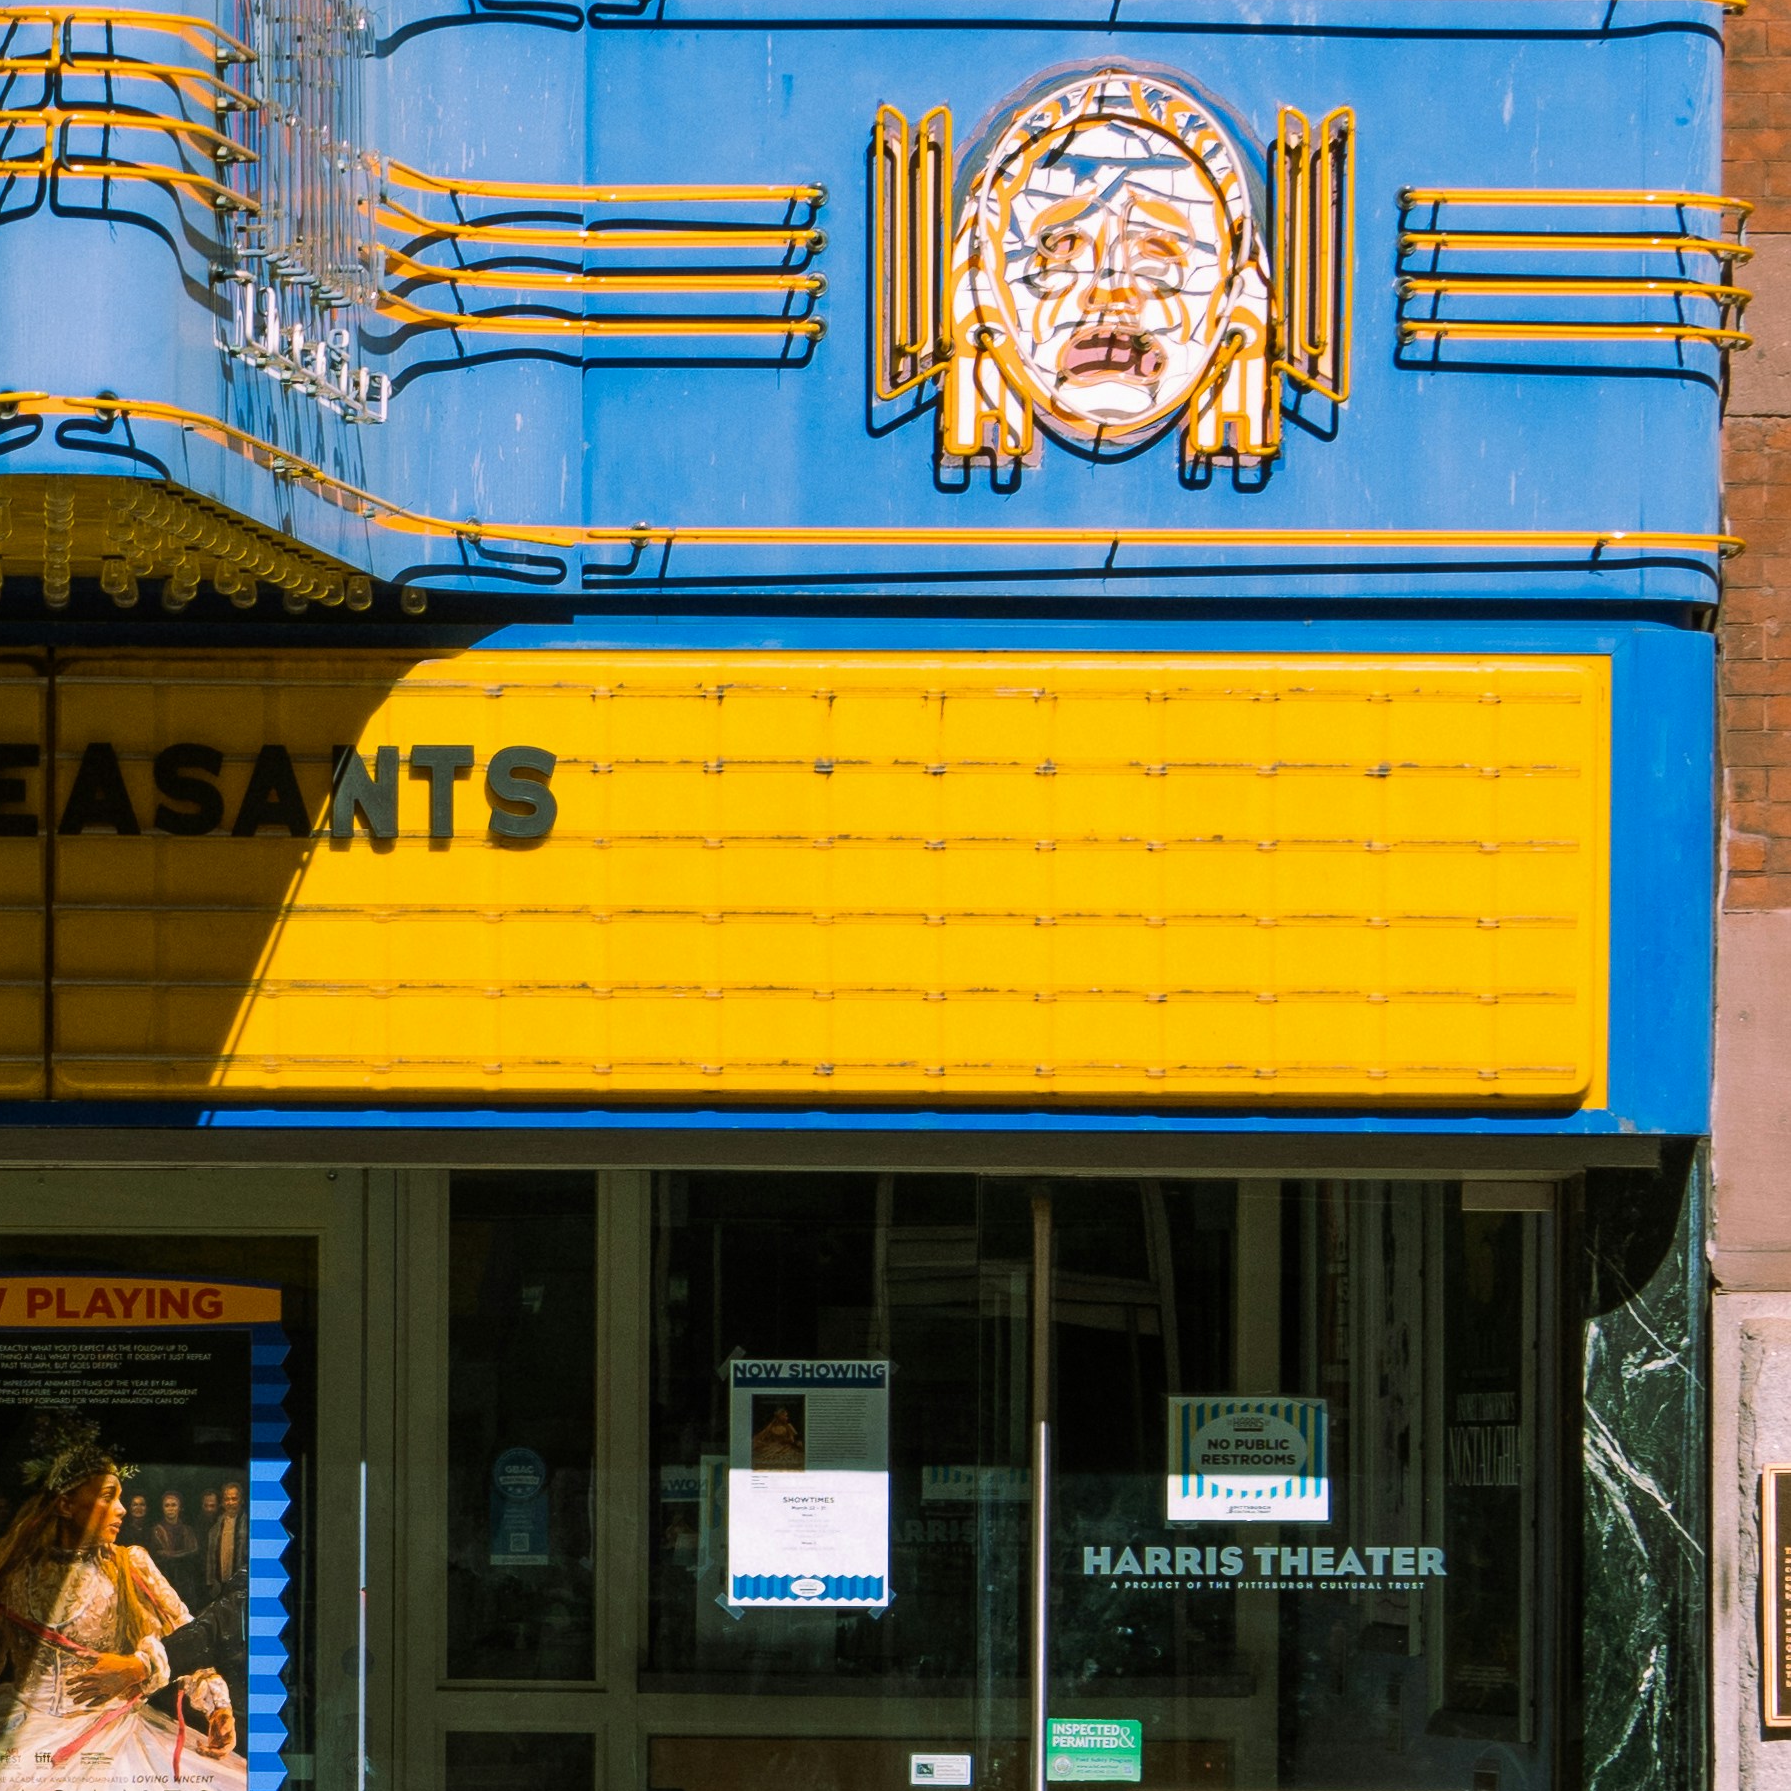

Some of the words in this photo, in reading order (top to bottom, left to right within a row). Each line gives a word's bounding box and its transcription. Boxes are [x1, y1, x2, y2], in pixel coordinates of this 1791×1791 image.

[27, 1287, 224, 1319] PLAYING
[30, 1344, 52, 1352] WHAT
[107, 1344, 117, 1352] AS
[119, 1344, 131, 1352] THE
[178, 1344, 189, 1352] TO
[48, 1353, 70, 1361] WHAT
[169, 1353, 186, 1361] JUST
[69, 1362, 91, 1370] GOES
[733, 1363, 783, 1378] NOW
[789, 1363, 886, 1378] SHOWING
[1208, 1439, 1230, 1450] NO
[1235, 1439, 1290, 1450] PUBLIC
[1201, 1454, 1296, 1465] RESTROOMS
[505, 1465, 535, 1474] GBAC
[1083, 1546, 1244, 1576] HARRIS
[1253, 1546, 1447, 1576] THEATER
[1110, 1581, 1118, 1590] A
[1124, 1581, 1180, 1590] PROJECT
[1186, 1581, 1202, 1590] OF
[1208, 1581, 1231, 1590] THE
[1237, 1581, 1314, 1590] PITTSBURGH
[1319, 1581, 1382, 1590] CULTURAL
[1388, 1581, 1425, 1590] TRUST
[1052, 1723, 1120, 1736] INSPECTED
[1119, 1726, 1136, 1748] &
[1052, 1736, 1119, 1748] PERMITTED
[131, 1776, 168, 1784] LOVING
